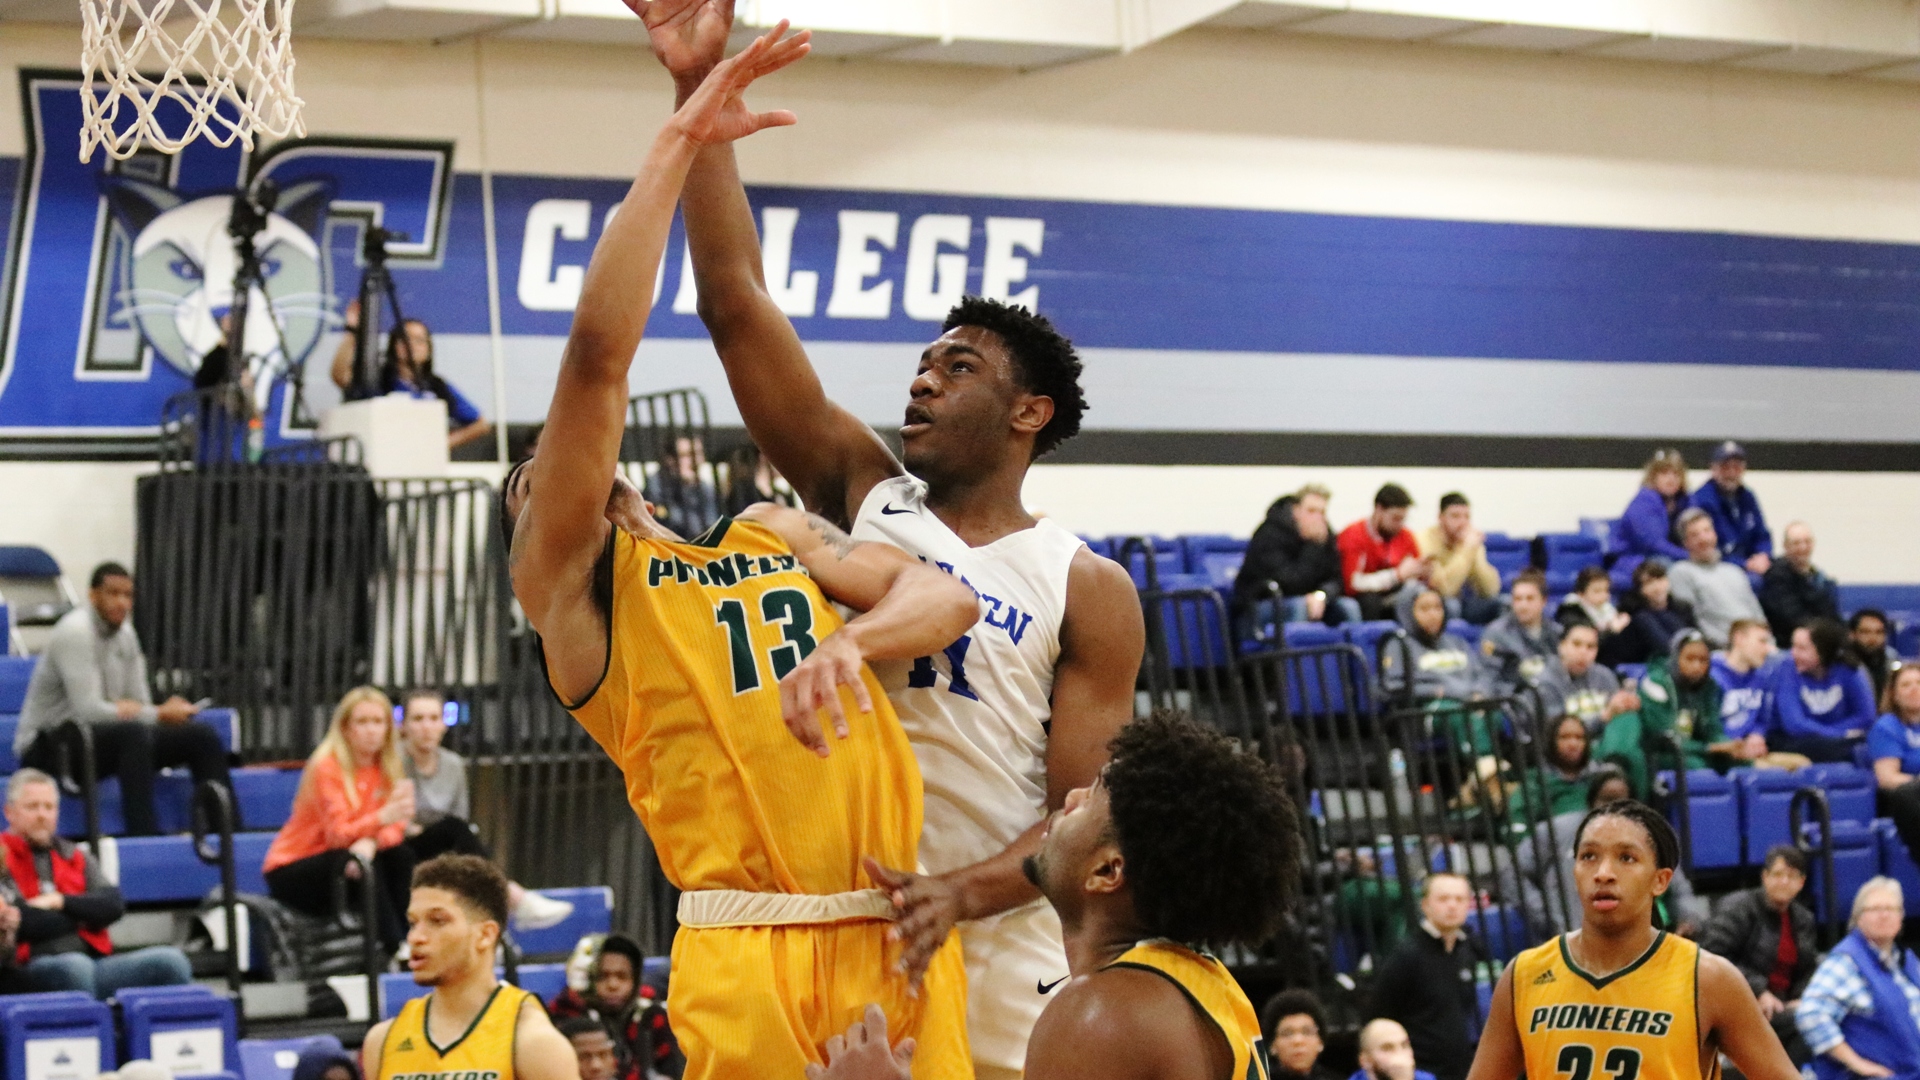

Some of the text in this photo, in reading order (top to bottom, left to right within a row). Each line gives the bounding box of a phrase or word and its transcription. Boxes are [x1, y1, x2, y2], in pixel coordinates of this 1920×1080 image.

[516, 198, 1045, 320] CLEGE
[712, 586, 819, 697] 13
[1529, 1002, 1674, 1037] PIONEERS
